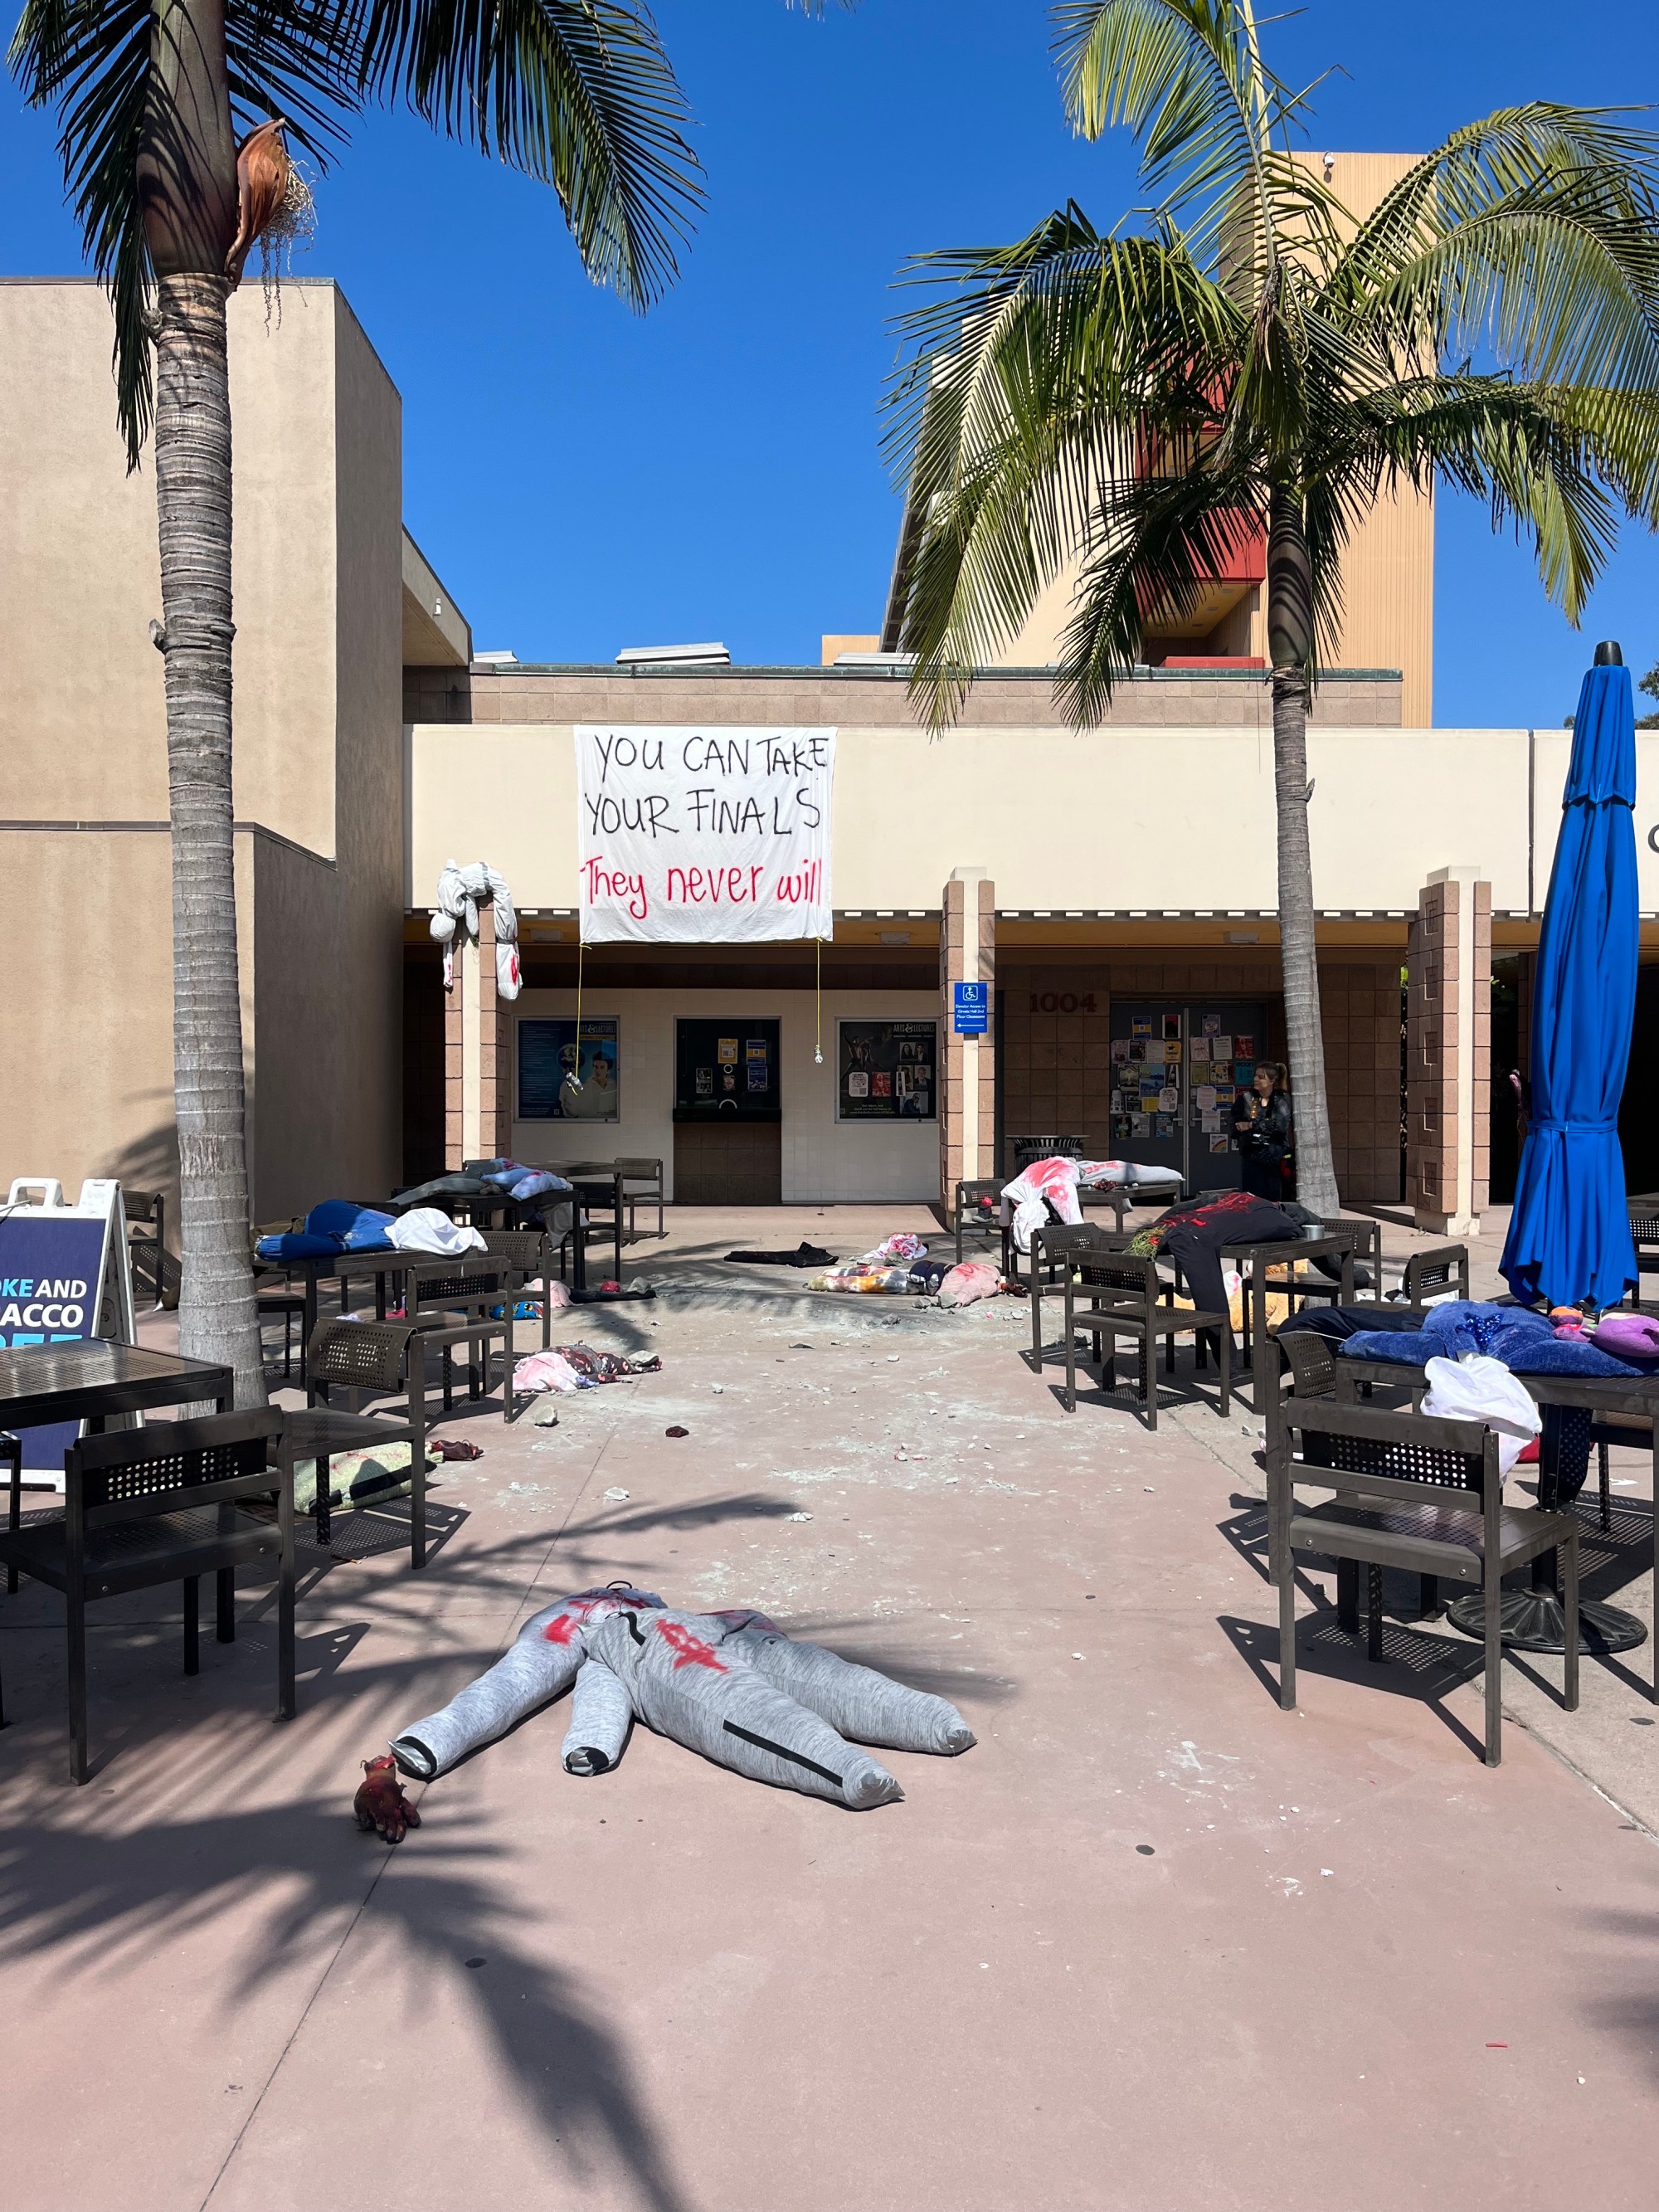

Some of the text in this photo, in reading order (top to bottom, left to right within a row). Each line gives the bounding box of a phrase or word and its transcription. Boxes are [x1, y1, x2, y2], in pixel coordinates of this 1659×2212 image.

[595, 734, 830, 783] YOU CAN TAKE
[585, 788, 820, 838] YOUR FINALS
[580, 856, 822, 919] They never will
[1030, 992, 1097, 1012] 1004
[0, 1278, 87, 1298] KE AND
